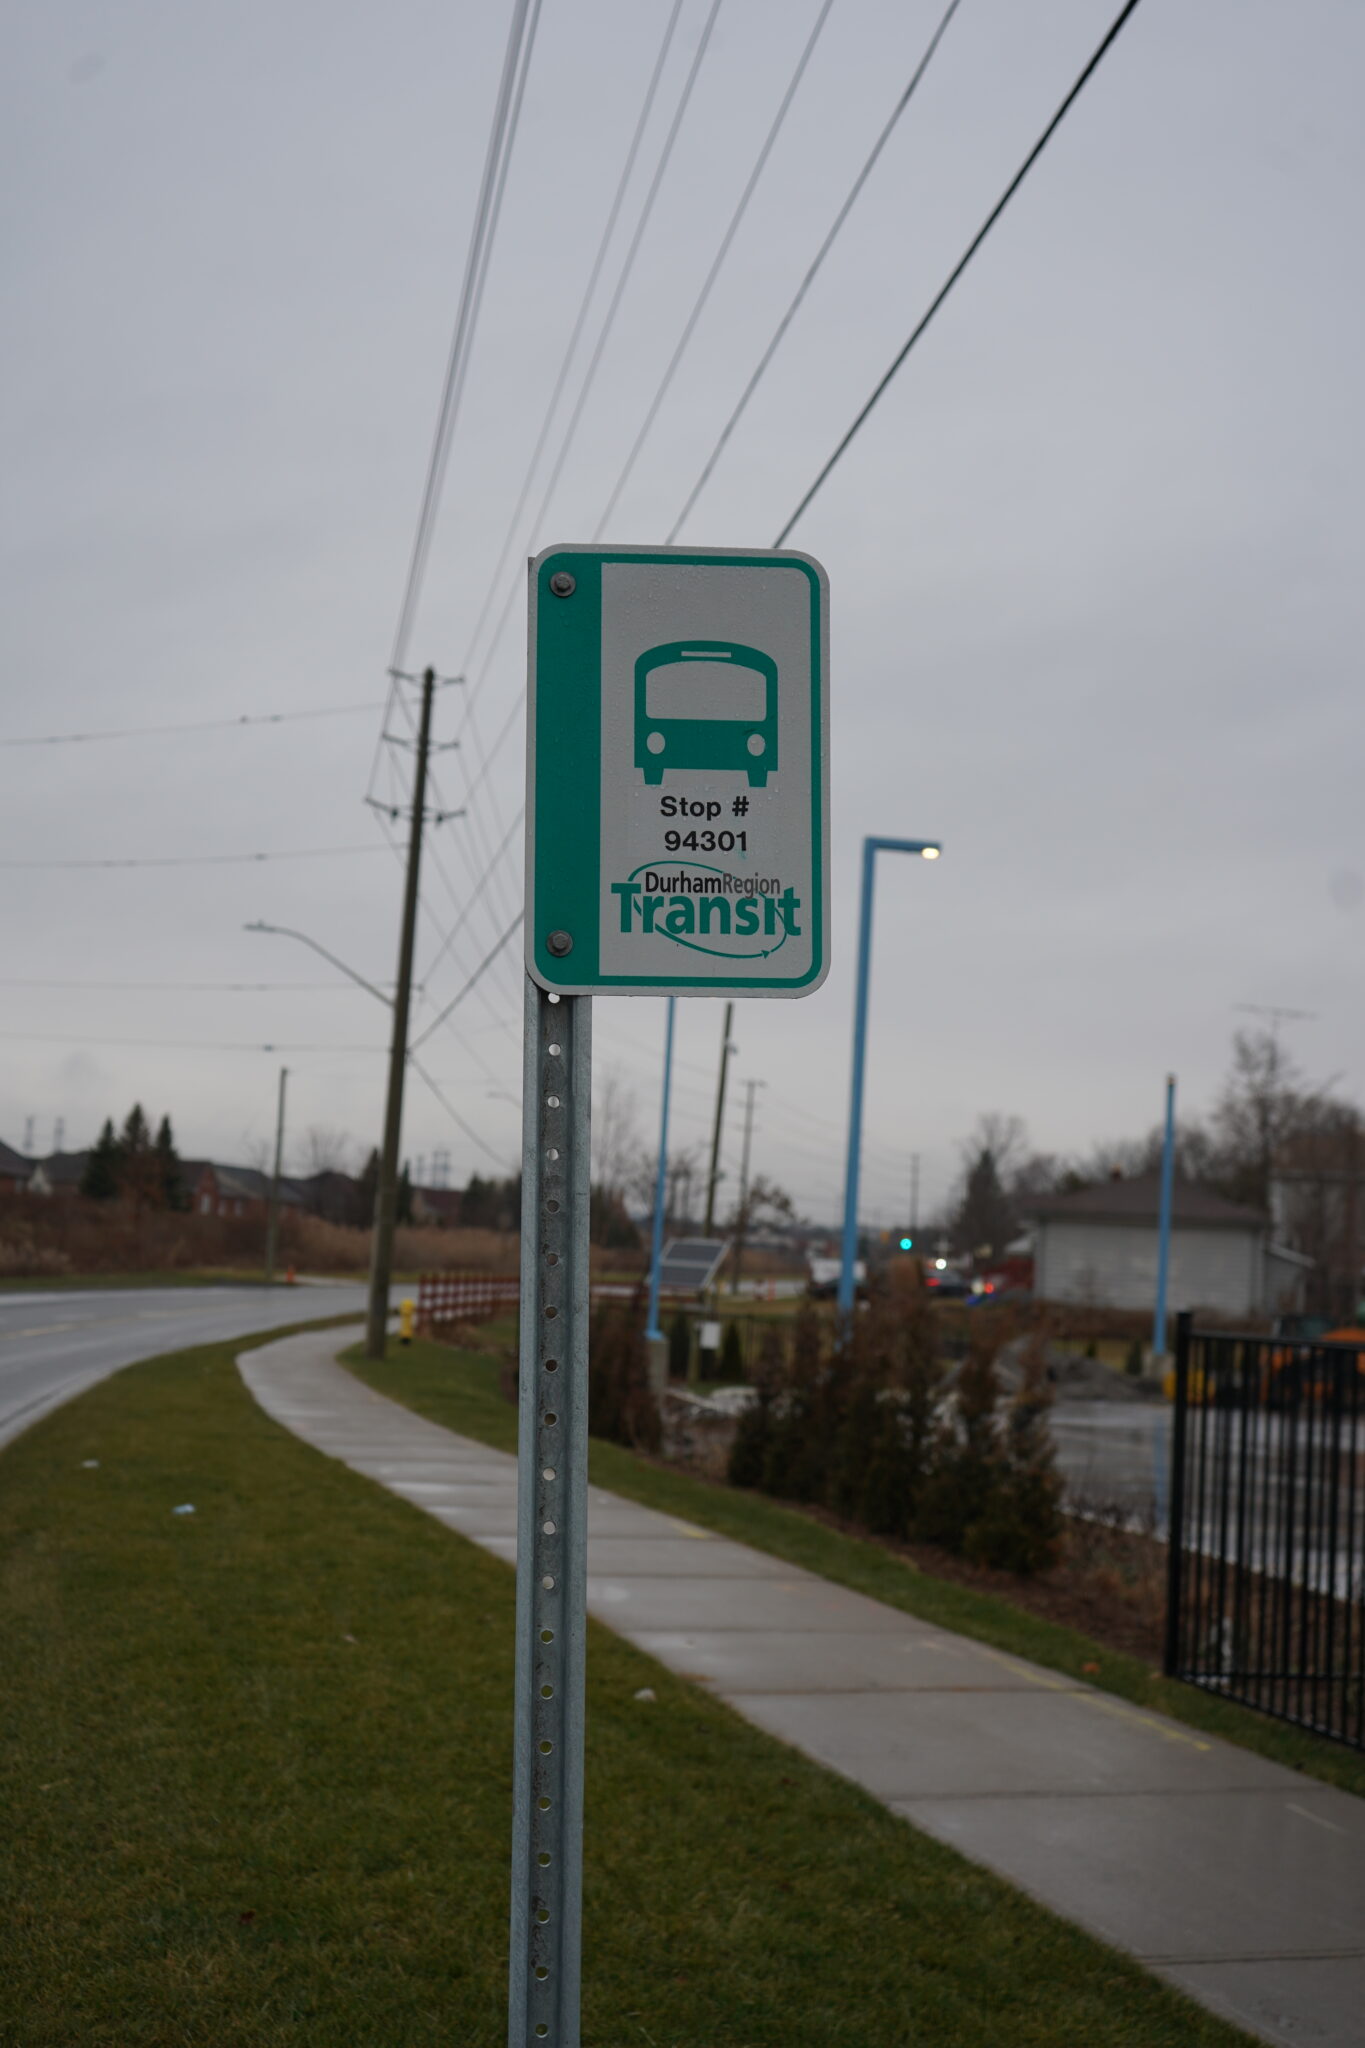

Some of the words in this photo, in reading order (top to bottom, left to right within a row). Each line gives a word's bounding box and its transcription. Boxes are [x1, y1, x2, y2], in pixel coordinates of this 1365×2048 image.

[660, 795, 722, 821] Stop
[731, 796, 750, 817] #
[664, 830, 747, 852] 94301
[611, 882, 802, 936] Transit
